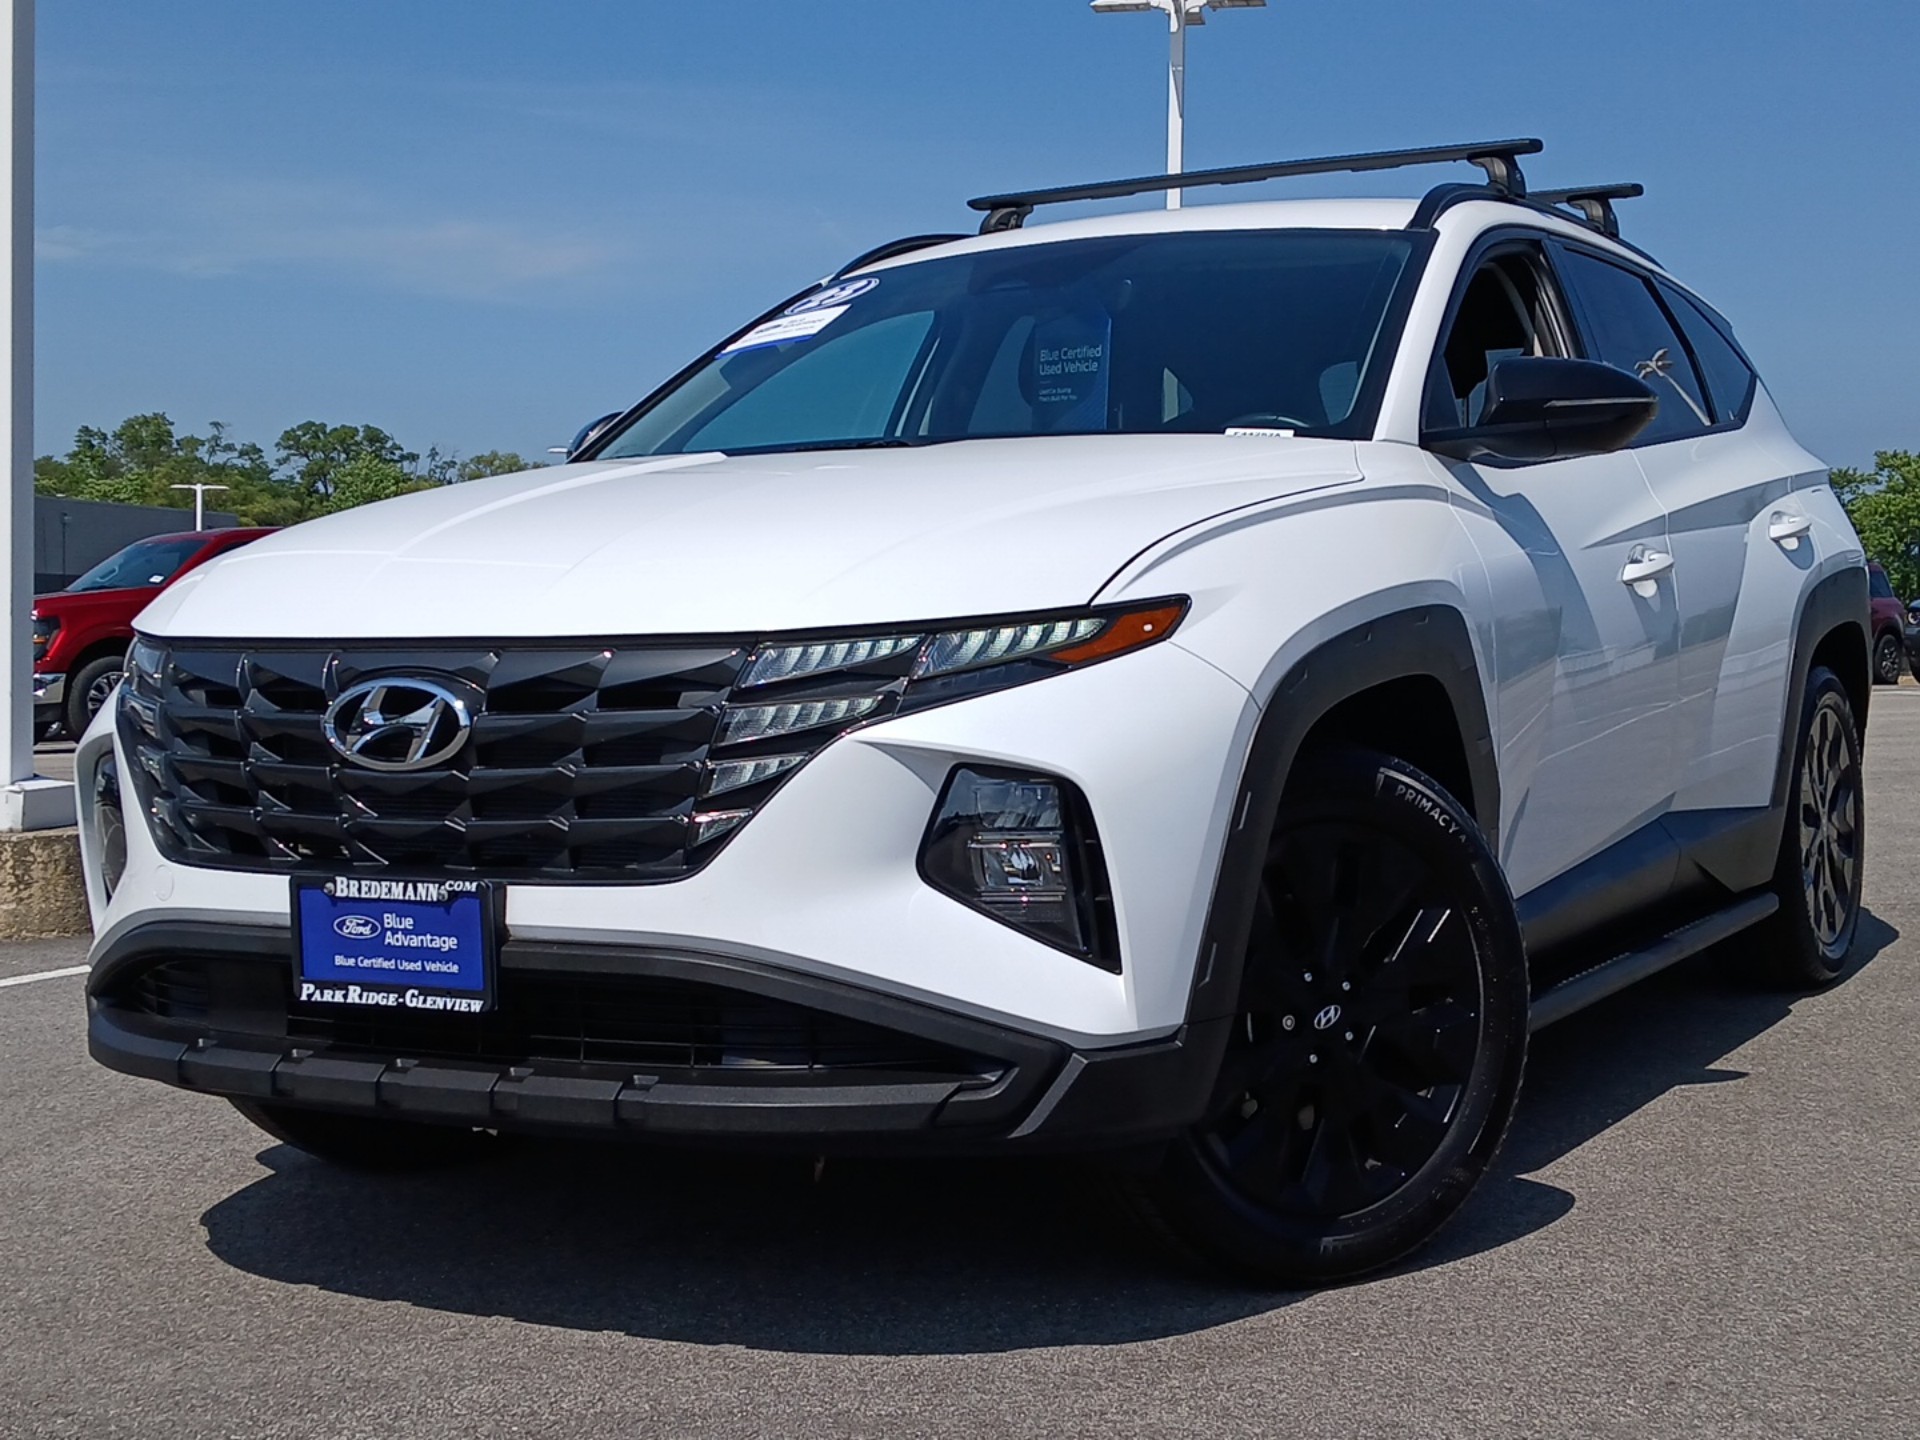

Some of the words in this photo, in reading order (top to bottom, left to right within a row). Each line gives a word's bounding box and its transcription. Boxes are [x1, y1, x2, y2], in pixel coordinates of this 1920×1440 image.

[1040, 349, 1059, 361] Blue
[1061, 344, 1102, 359] Certified
[1040, 361, 1062, 375] Used
[1064, 359, 1098, 373] Vehicle
[1395, 784, 1459, 834] PRIMACY
[335, 876, 438, 901] BREDEMANN
[383, 913, 414, 929] Blue
[384, 931, 458, 952] Advantage
[334, 955, 355, 967] Blue
[357, 956, 395, 970] Certified
[397, 959, 422, 971] Used
[424, 960, 459, 973] Vehicle
[300, 983, 346, 1001] PARK
